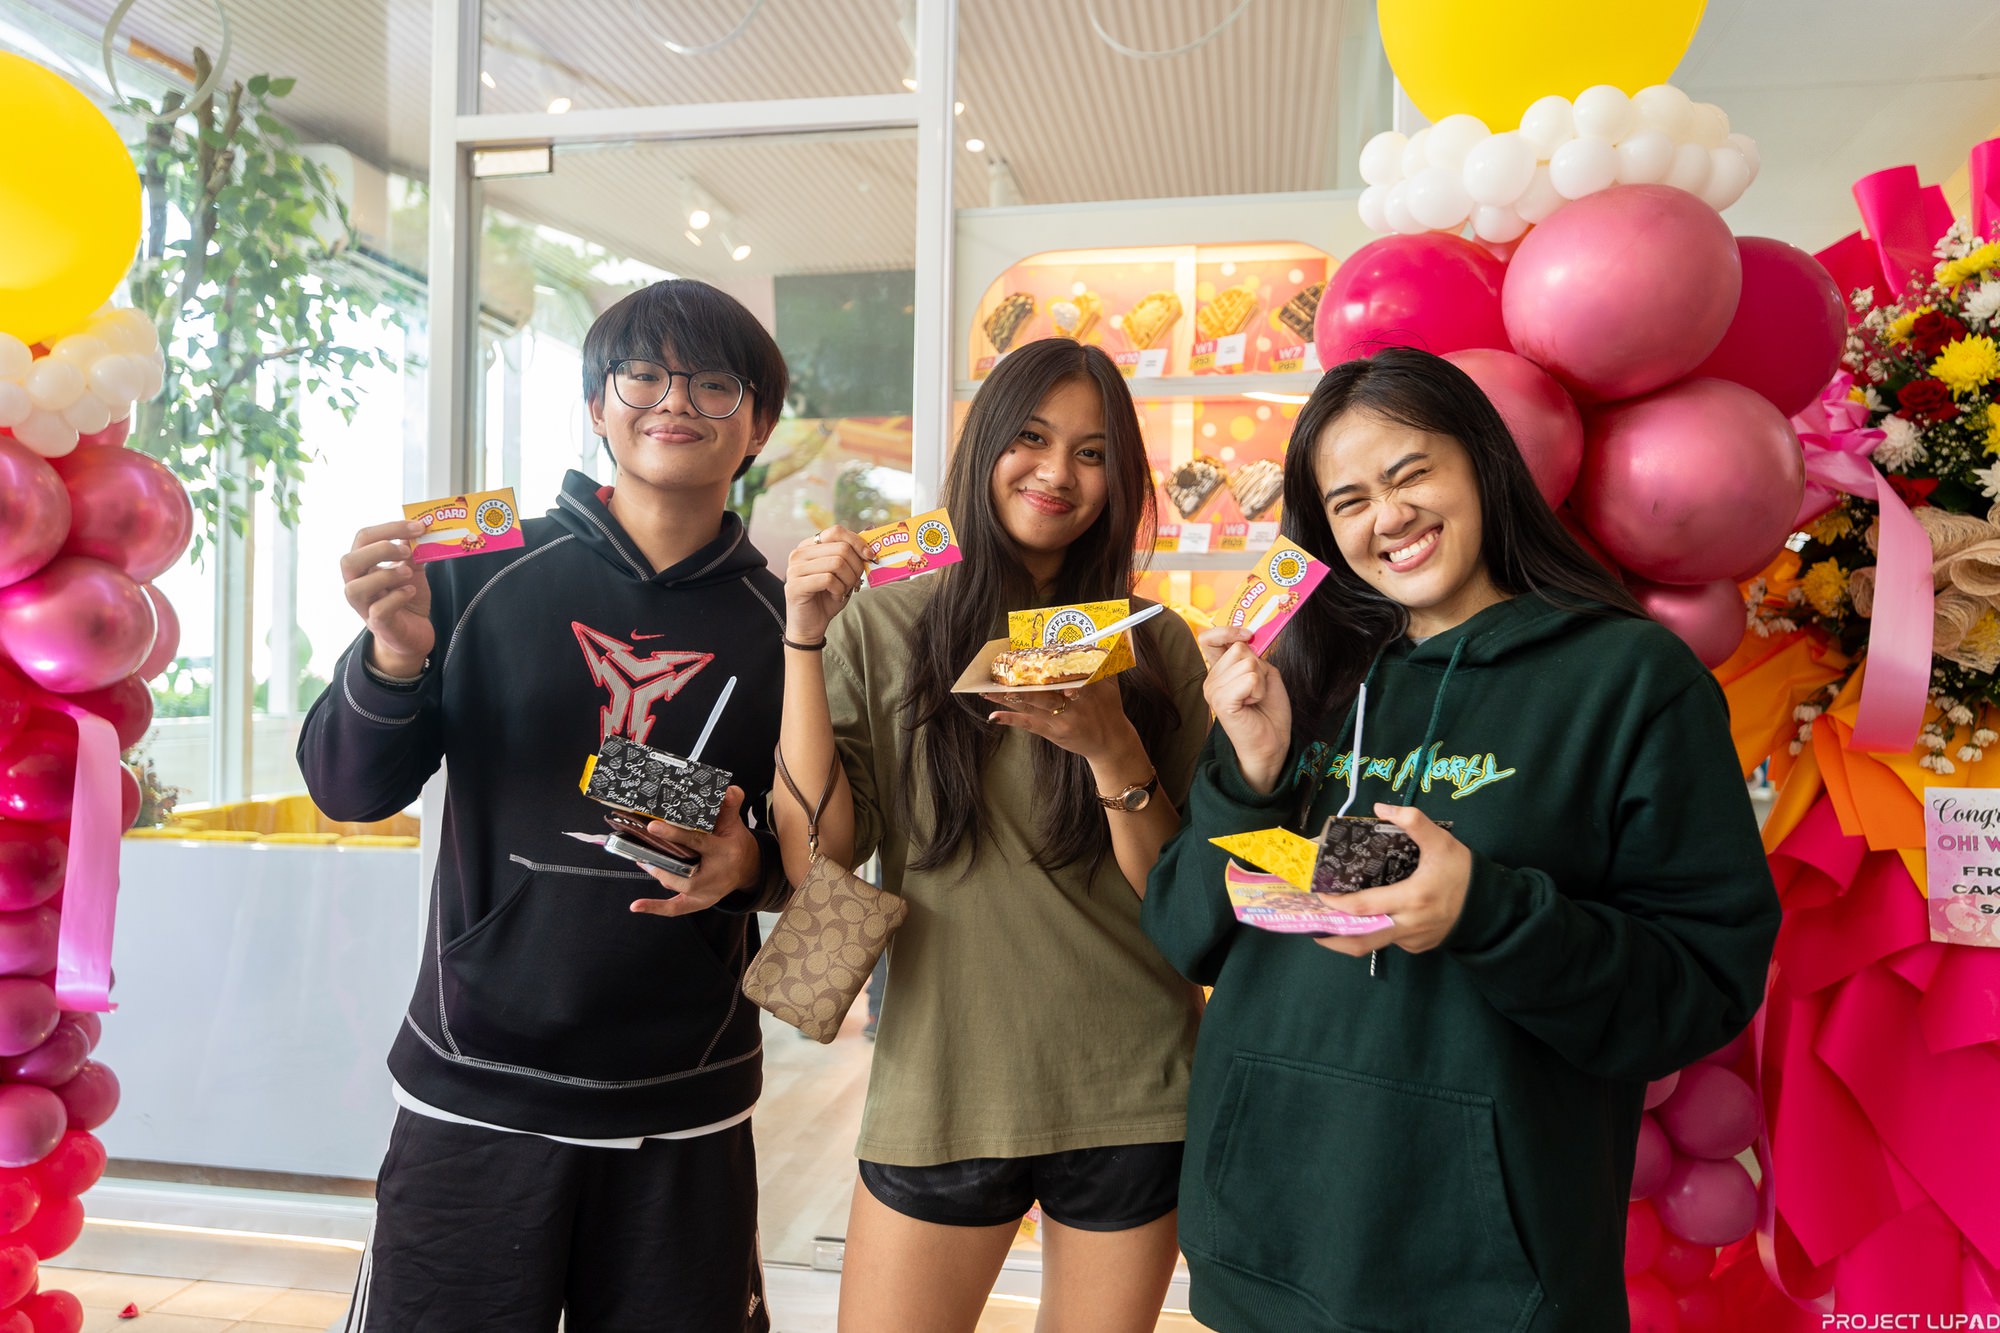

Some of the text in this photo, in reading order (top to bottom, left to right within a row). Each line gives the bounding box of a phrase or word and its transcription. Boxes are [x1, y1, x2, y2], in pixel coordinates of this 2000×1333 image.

[1195, 342, 1214, 354] W1
[1279, 347, 1303, 359] W7
[436, 508, 467, 521] CARD
[477, 501, 498, 524] WAFFLES
[503, 508, 513, 533] CREPES
[882, 533, 909, 547] CARD
[918, 522, 935, 545] WAFFLES
[940, 527, 949, 550] CREPES
[1271, 554, 1283, 584] WAFFLES
[1290, 552, 1306, 574] CREPES
[1232, 609, 1245, 627] VIP
[1240, 582, 1267, 609] CARD
[1048, 614, 1077, 642] AFFLES
[1937, 834, 1980, 852] OH!
